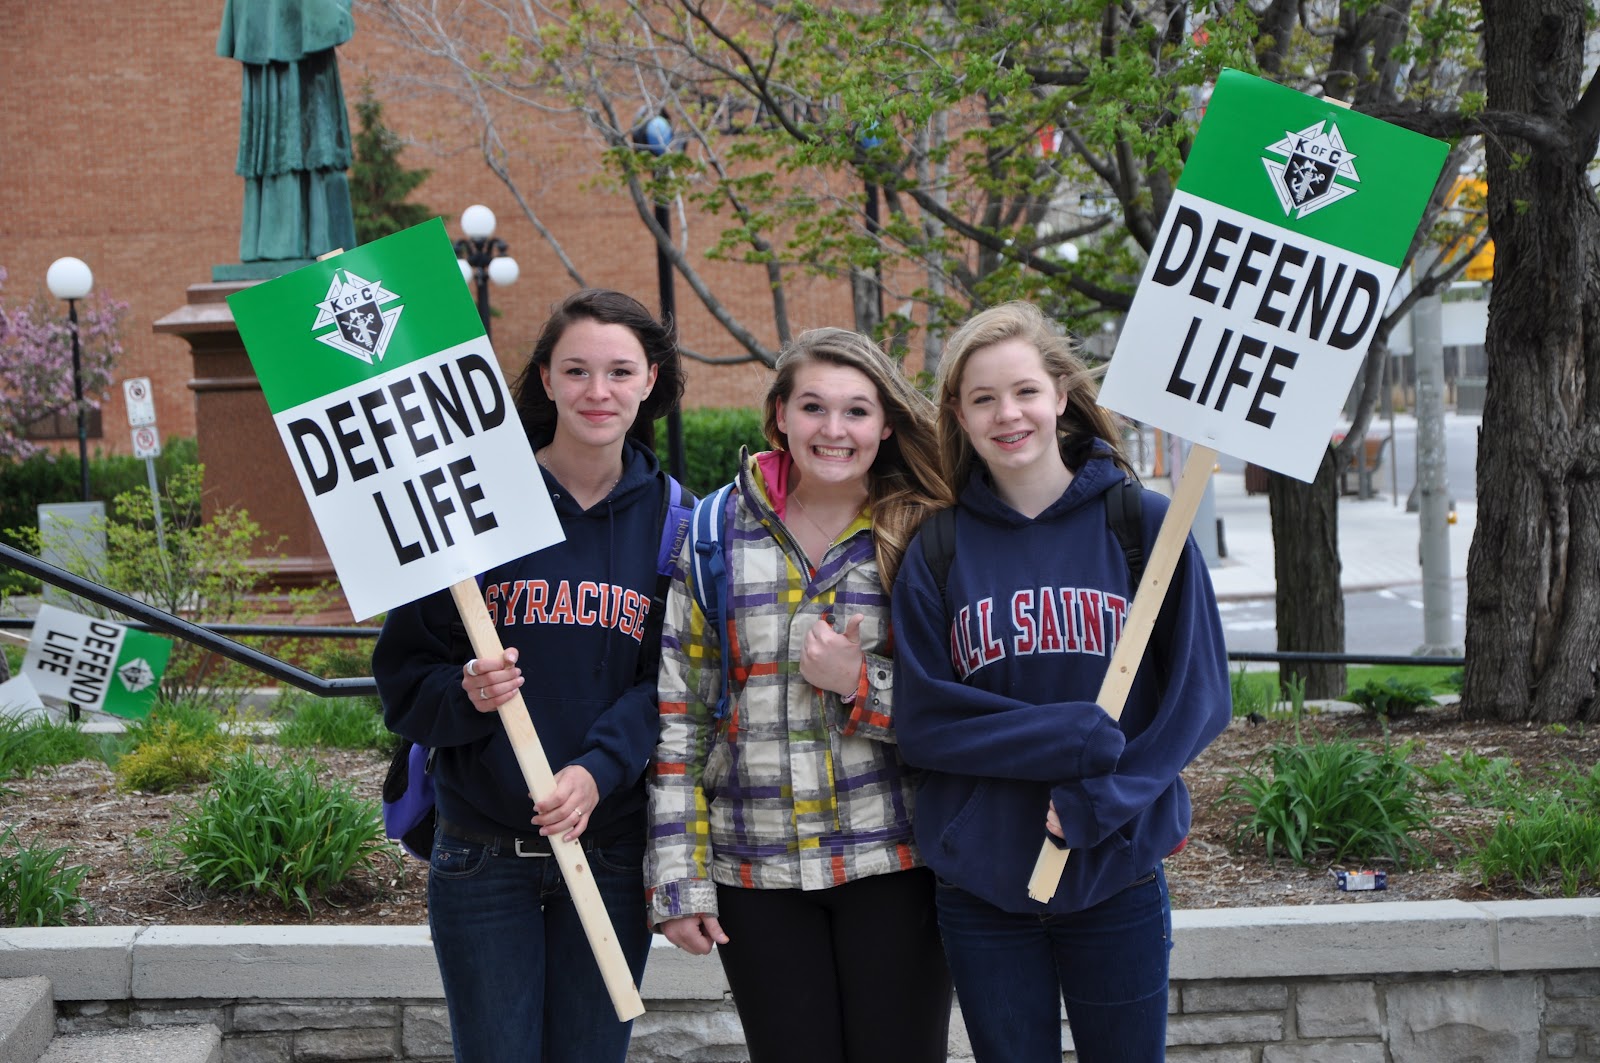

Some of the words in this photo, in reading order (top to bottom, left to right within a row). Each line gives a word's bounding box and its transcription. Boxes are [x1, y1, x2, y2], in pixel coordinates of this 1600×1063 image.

[1295, 138, 1310, 153] K
[1328, 150, 1342, 164] C
[330, 298, 344, 313] K
[361, 287, 373, 301] C
[1151, 205, 1381, 351] DEFEND
[1165, 316, 1300, 430] LIFE
[287, 353, 506, 497] DEFEND
[372, 455, 499, 566] LIFE
[672, 518, 689, 553] Hurley
[485, 579, 651, 645] SYRACUSE
[1012, 587, 1132, 660] SAINT
[37, 630, 78, 676] LIFE
[69, 622, 120, 704] DEFEND
